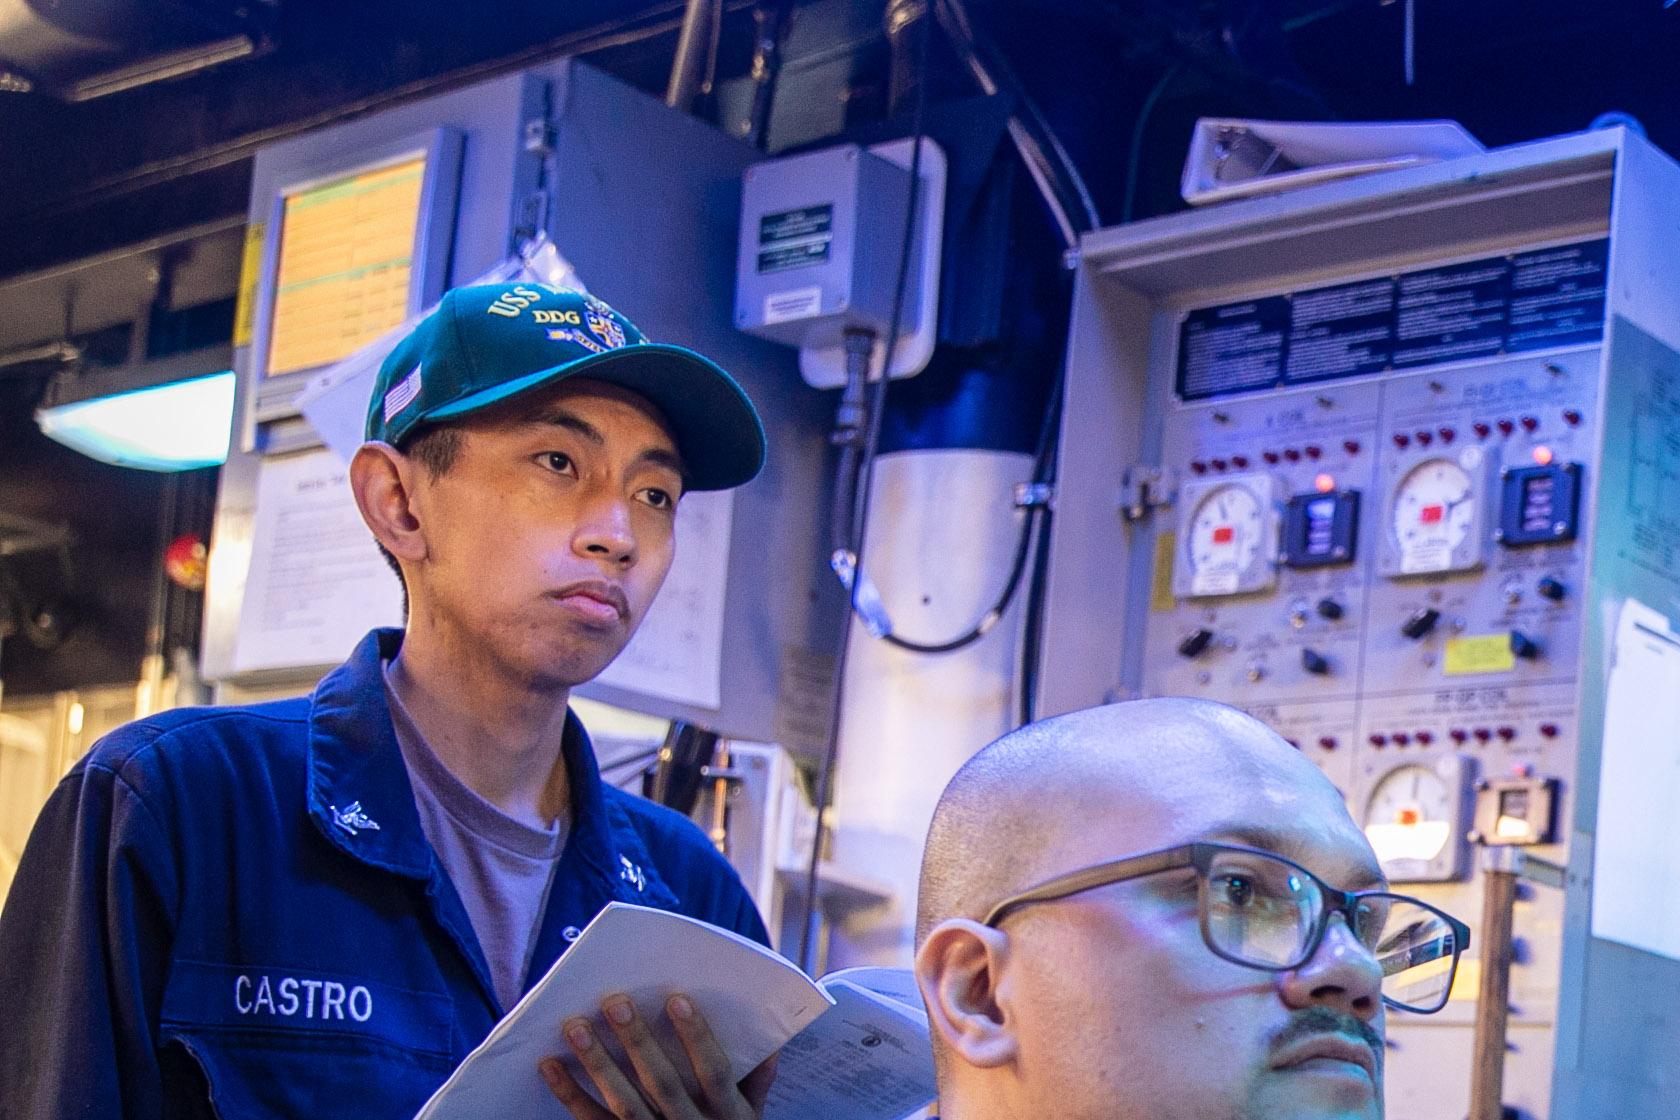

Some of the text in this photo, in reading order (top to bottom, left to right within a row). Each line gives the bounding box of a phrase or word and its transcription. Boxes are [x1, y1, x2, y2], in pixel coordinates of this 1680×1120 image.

[487, 286, 541, 318] USS
[531, 310, 580, 325] DDG
[235, 974, 373, 1022] CASTRO
